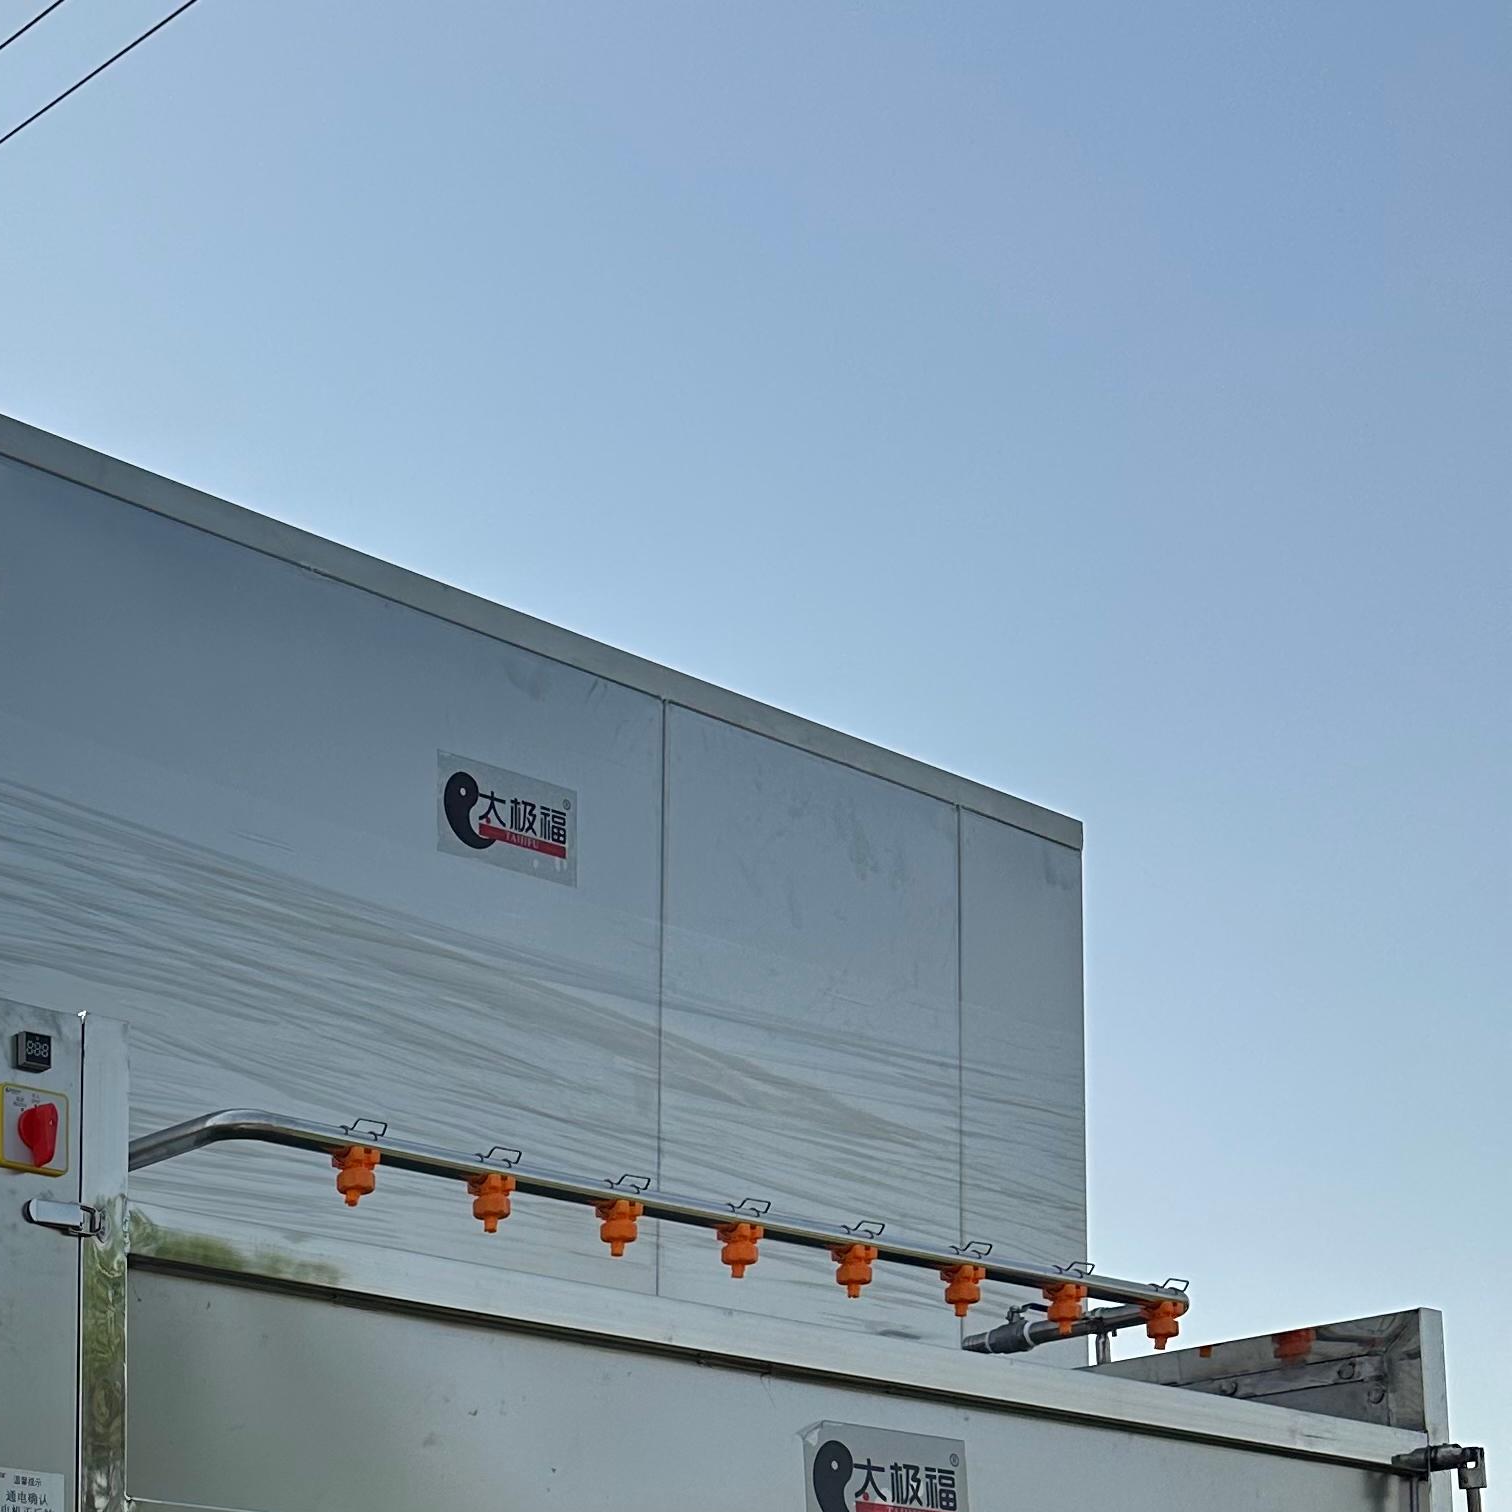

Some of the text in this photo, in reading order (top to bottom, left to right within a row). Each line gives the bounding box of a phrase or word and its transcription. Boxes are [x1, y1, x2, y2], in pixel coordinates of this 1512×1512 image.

[478, 790, 567, 845] 太极福
[6, 1489, 48, 1506] 通电确认
[853, 1458, 958, 1512] 太极福
